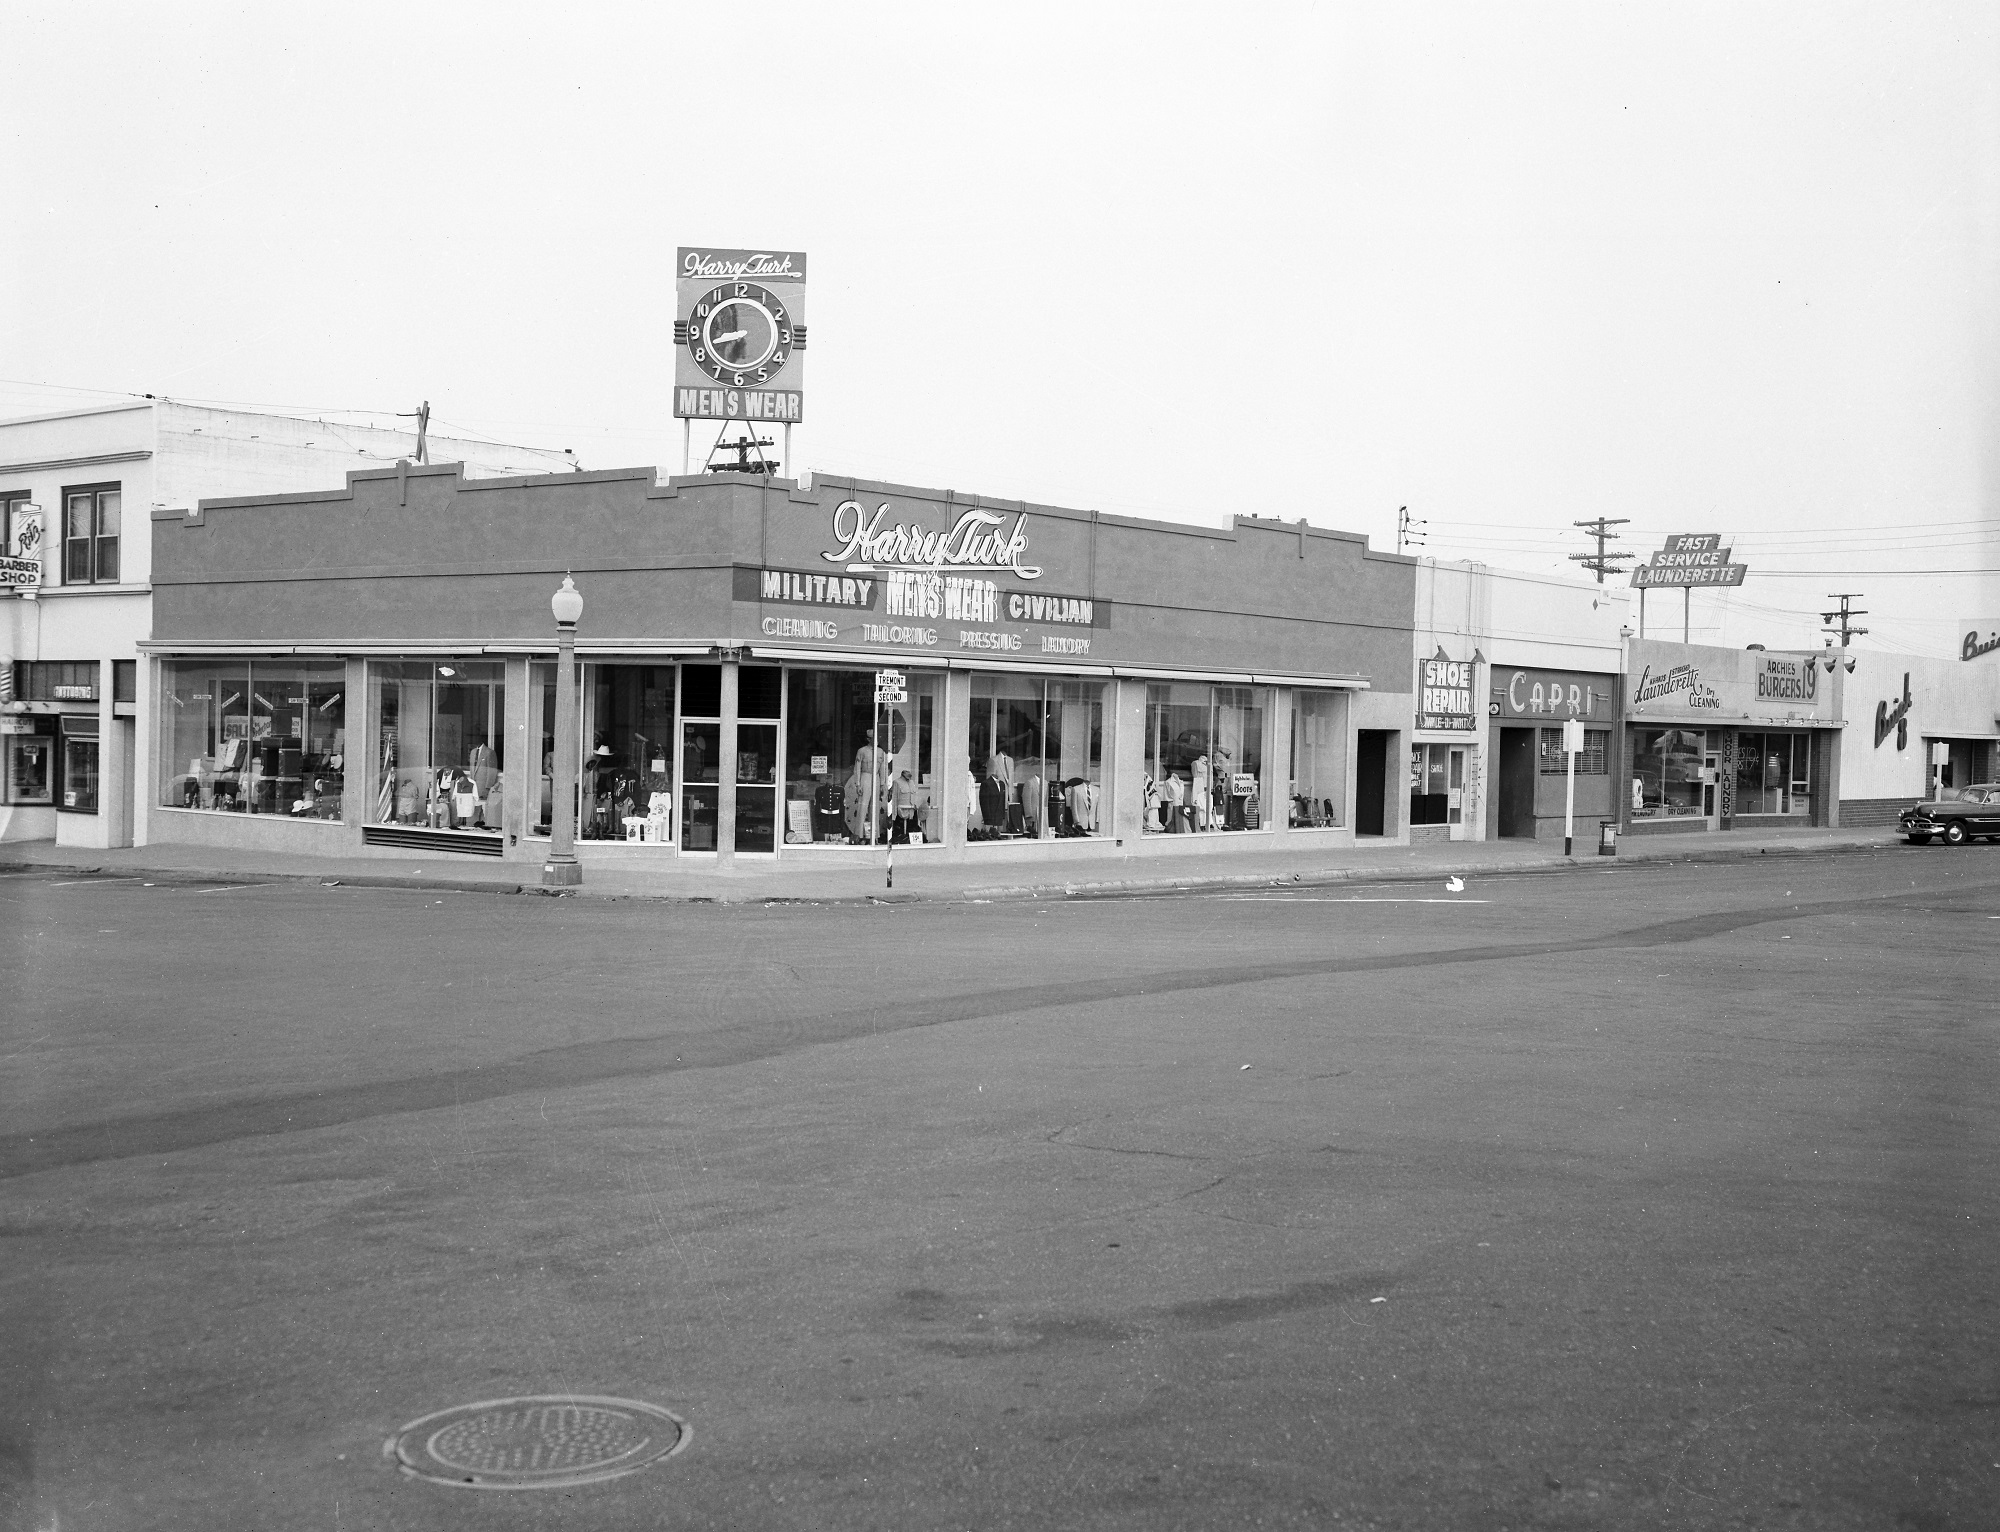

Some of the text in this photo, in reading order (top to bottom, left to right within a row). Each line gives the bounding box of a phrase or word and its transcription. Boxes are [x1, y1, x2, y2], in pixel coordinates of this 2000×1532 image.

[682, 252, 802, 281] Harry Turk
[713, 289, 722, 303] 11
[734, 284, 748, 298] 12
[762, 291, 766, 306] 1
[696, 303, 710, 318] 10
[774, 307, 784, 321] 2
[690, 325, 700, 340] 9
[781, 331, 791, 344] 3
[695, 347, 706, 362] 8
[772, 351, 785, 365] 4
[712, 366, 721, 379] 7
[733, 372, 744, 386] 6
[757, 367, 768, 382] 5
[679, 389, 799, 419] MEN'S WEAR
[821, 500, 1043, 580] Harry Turk
[1675, 536, 1712, 551] FAST
[0, 560, 39, 573] BARBER
[1655, 551, 1720, 567] SERVICE
[0, 571, 36, 584] SHOP
[1636, 567, 1737, 584] LAUNDERETTE
[761, 570, 1093, 624] MILITARY MEN'S WEAR CIVILIAN
[761, 616, 1091, 656] CLEANING TAILORING PRESSING LAUNDRY
[1426, 660, 1471, 688] SHOE
[1766, 660, 1796, 676] ARCHIES
[878, 675, 904, 686] TREMONT
[1634, 664, 1702, 704] Launderette
[1758, 672, 1801, 699] BURGERS
[878, 692, 902, 702] SECOND
[1509, 670, 1592, 716] CAPRI
[1706, 687, 1715, 698] Dry
[1423, 687, 1472, 714] REPAIR
[1689, 692, 1719, 709] CLEANING
[1874, 672, 1912, 749] Buick
[1, 718, 33, 726] HAIRCUT
[1897, 717, 1908, 751] 8
[1724, 738, 1732, 764] HOUR
[1722, 768, 1732, 817] LAUNDRY
[1668, 808, 1677, 816] DRY
